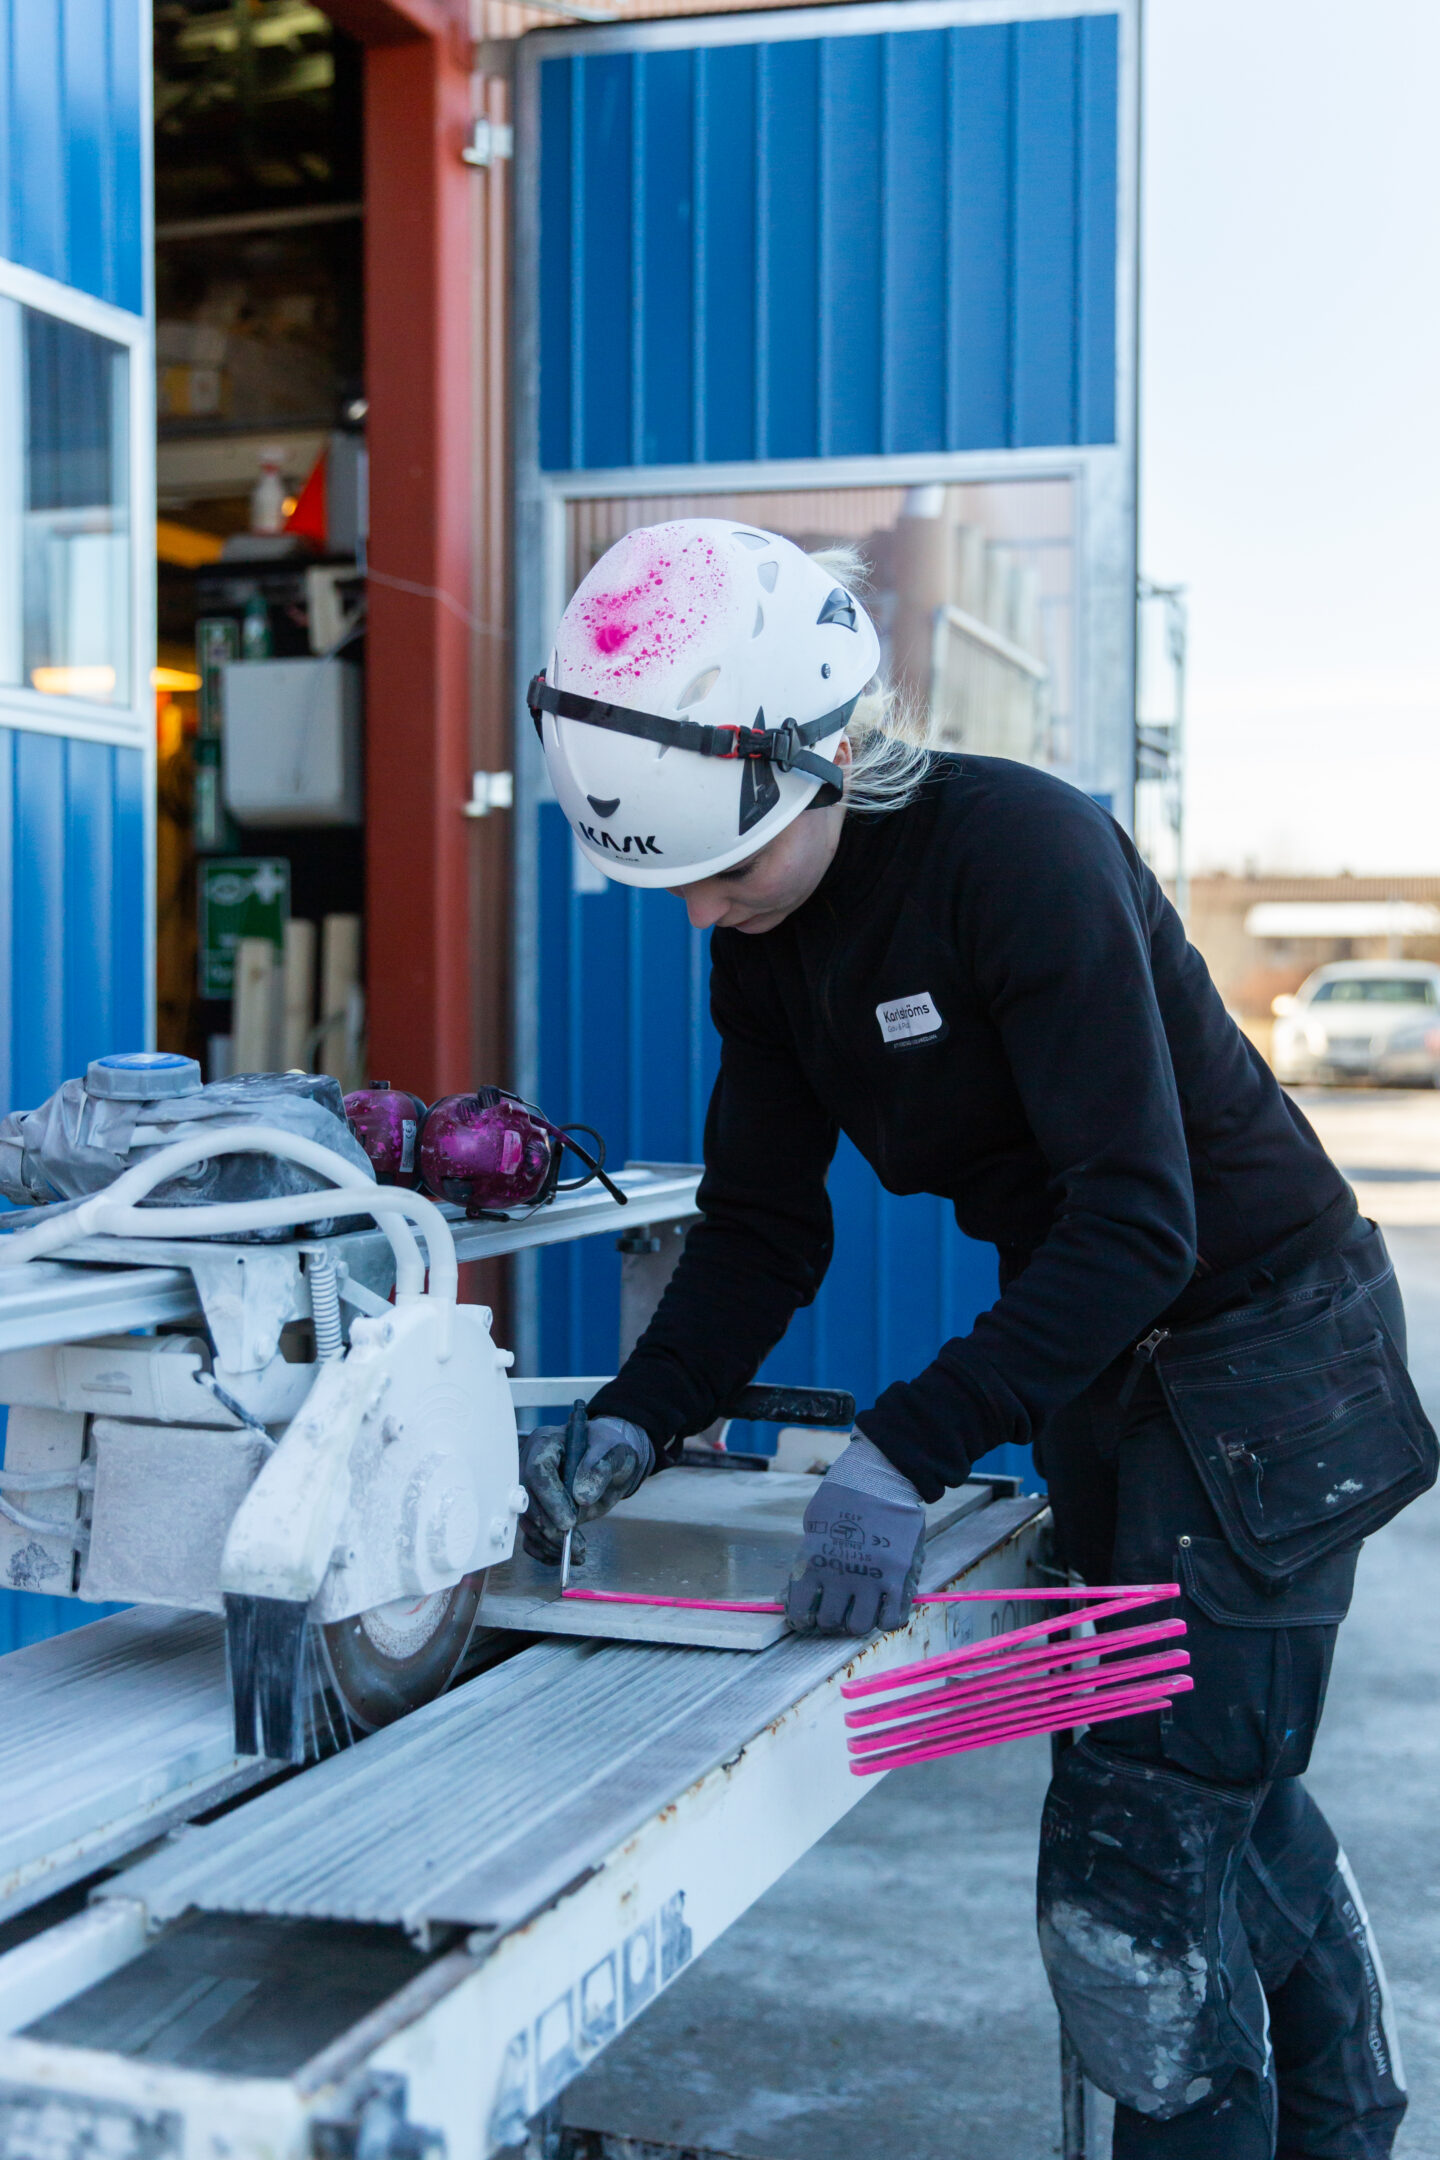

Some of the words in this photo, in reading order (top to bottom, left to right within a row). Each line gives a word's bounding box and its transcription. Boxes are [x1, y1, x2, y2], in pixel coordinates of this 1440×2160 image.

[579, 821, 664, 855] KASK
[883, 1004, 930, 1023] Karlströms
[811, 1554, 884, 1579] embo
